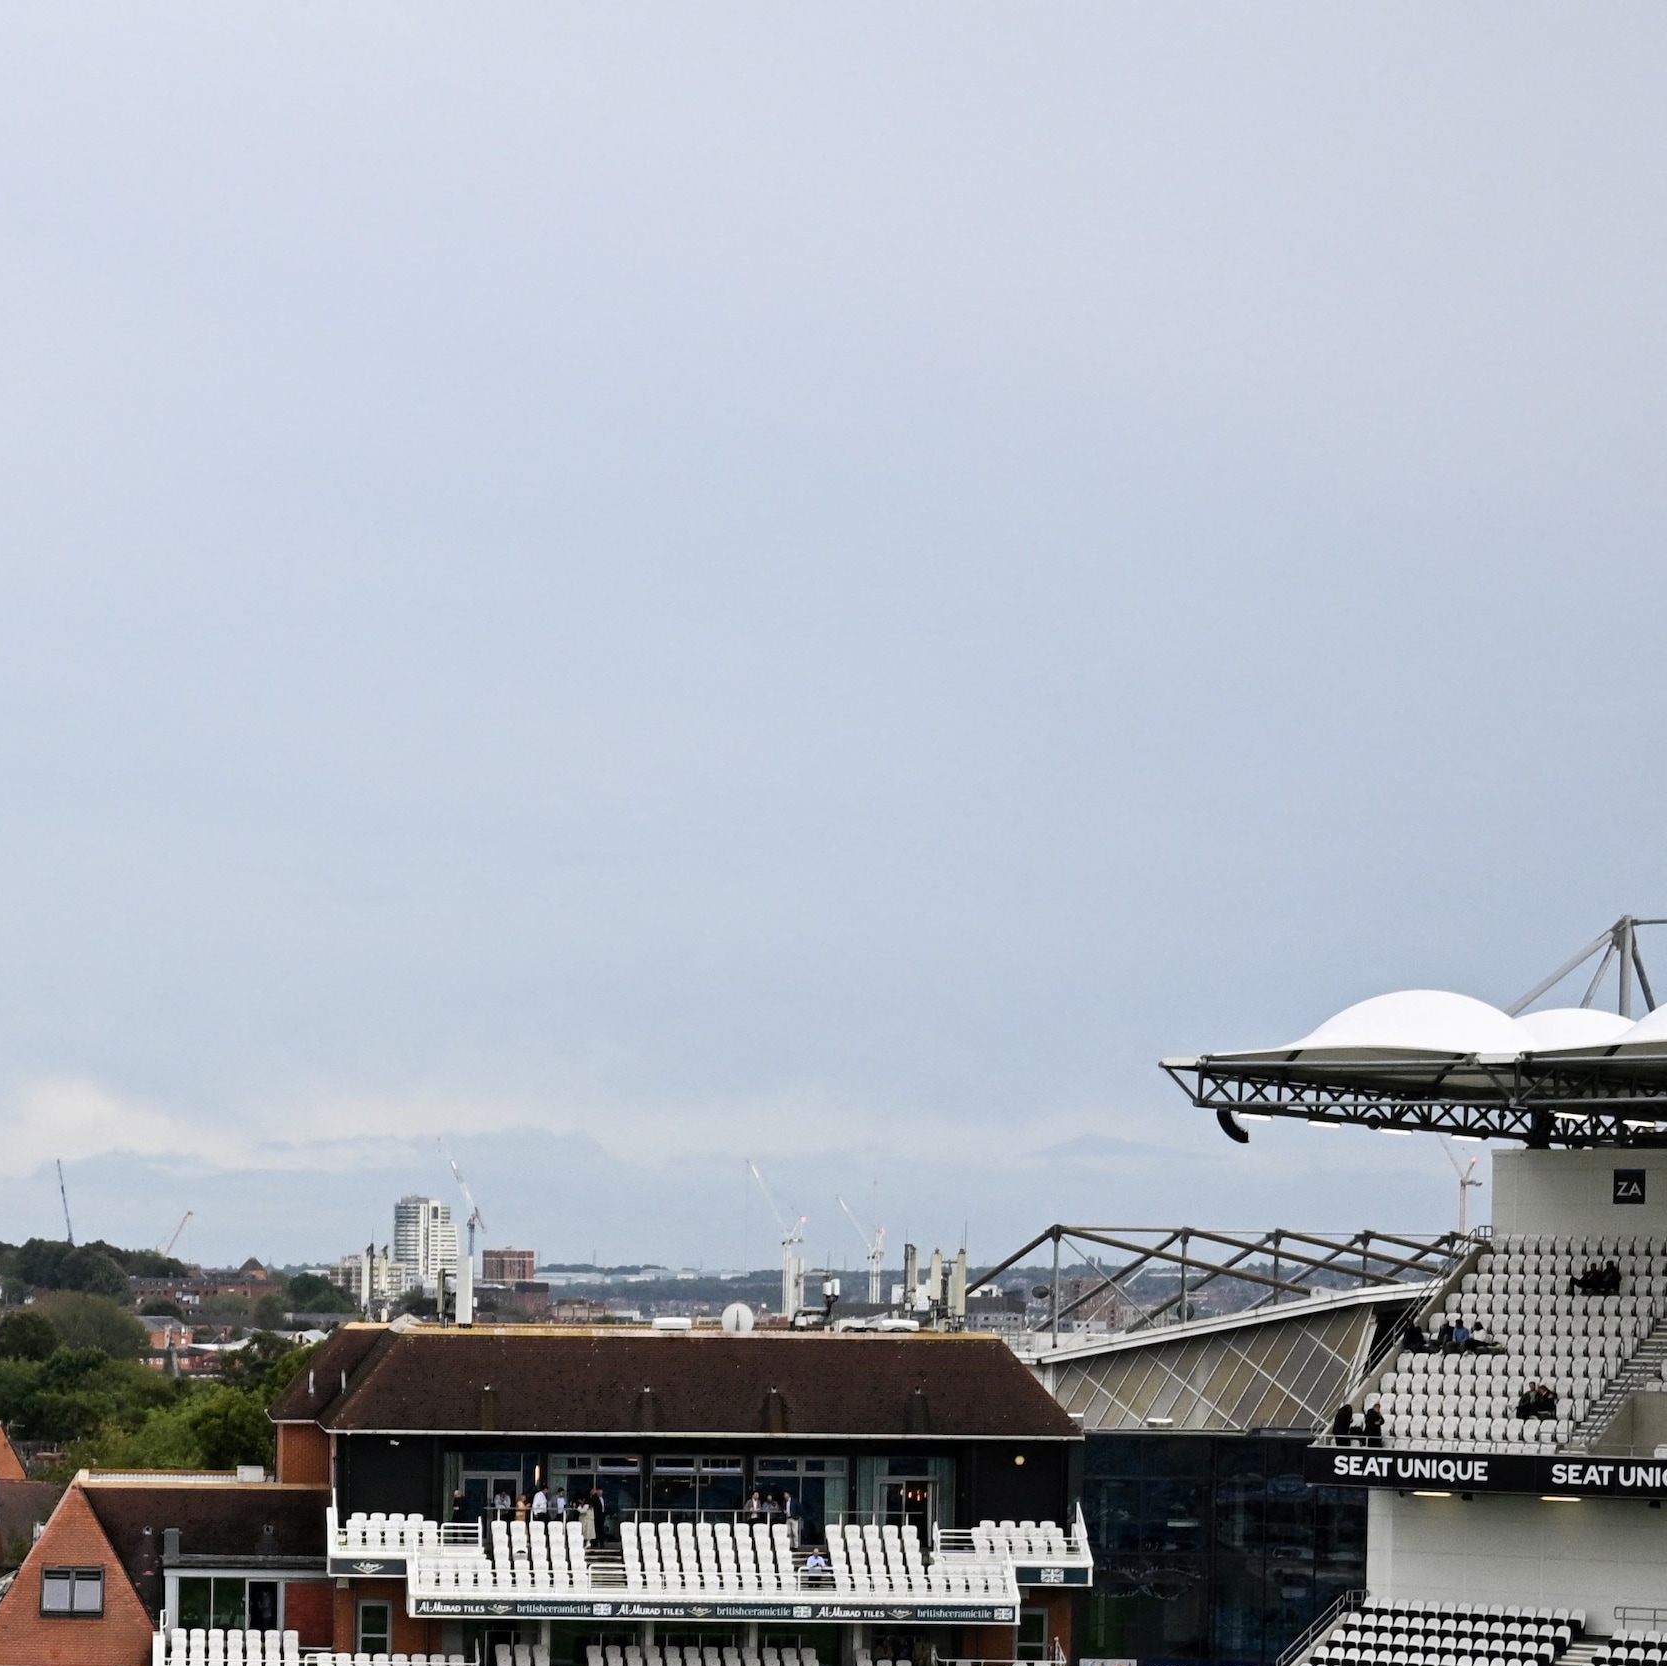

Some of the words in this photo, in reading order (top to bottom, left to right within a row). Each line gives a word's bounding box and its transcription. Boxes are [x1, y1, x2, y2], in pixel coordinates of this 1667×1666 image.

[1617, 1182, 1642, 1196] ZA
[1333, 1454, 1393, 1477] SEAT
[1397, 1458, 1488, 1483] UNIQUE
[1551, 1463, 1613, 1486] SEAT
[463, 1604, 485, 1613] TILES
[663, 1607, 685, 1616] TILES
[863, 1610, 885, 1618] TILES
